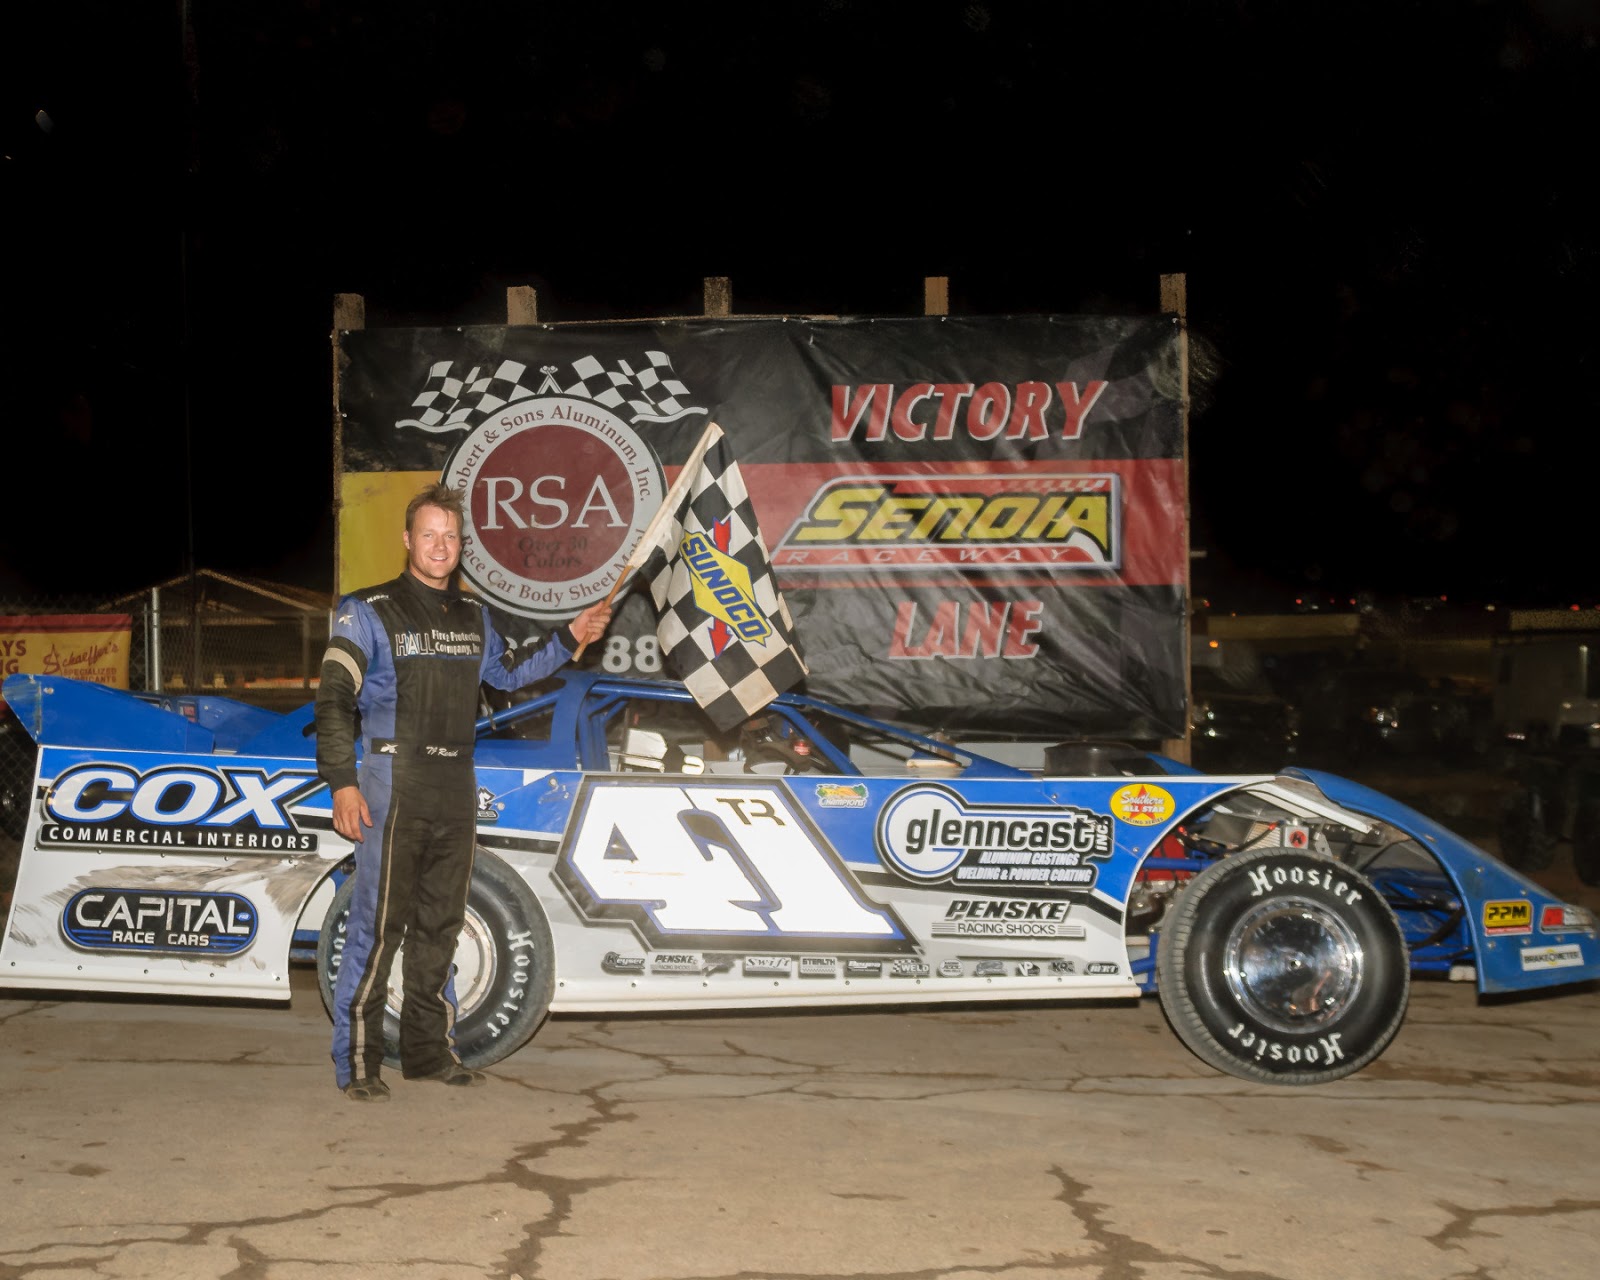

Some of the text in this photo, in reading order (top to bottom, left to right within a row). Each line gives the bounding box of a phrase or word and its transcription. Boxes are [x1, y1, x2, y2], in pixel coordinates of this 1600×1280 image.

[831, 380, 1109, 442] VICTORY
[456, 405, 650, 501] obert & Sons Aluminum, Inc.
[481, 475, 628, 530] RSA
[792, 483, 1109, 561] SENOIA
[519, 537, 560, 552] Over
[787, 548, 1078, 563] RACEWAY
[462, 534, 486, 573] Race
[487, 570, 515, 593] Car
[519, 586, 564, 607] Body
[569, 571, 617, 600] Sheet
[524, 552, 582, 569] Colors
[682, 537, 767, 637] SUNOCO
[888, 600, 1044, 660] LANE
[395, 631, 435, 656] HALL
[43, 641, 118, 675] Schaeffer's
[63, 668, 117, 676] SPECIALIZED
[49, 769, 311, 829] COX
[1120, 791, 1164, 804] Southern
[1142, 805, 1164, 813] STAR
[715, 797, 785, 827] TR
[49, 826, 310, 849] COMMERCIAL INTERIORS
[906, 809, 1109, 854] glenncast INC.
[571, 785, 896, 935] 41
[979, 852, 1080, 866] ALUMINUM CASTINGS
[957, 867, 1092, 882] WELDING & POWDER COATING
[1248, 864, 1364, 906] Hoosier
[76, 895, 250, 934] CAPITAL
[945, 900, 1067, 922] PENSKE
[1488, 905, 1527, 920] PPM
[112, 930, 210, 947] RACE CARS
[958, 923, 1056, 935] RACING SHOCKS
[655, 955, 694, 963] PENSKE
[747, 956, 791, 968] Swift
[802, 958, 835, 966] STEALTH
[901, 964, 929, 972] WELD
[487, 930, 535, 1038] Hoosier
[1227, 1022, 1345, 1065] Hoosier
